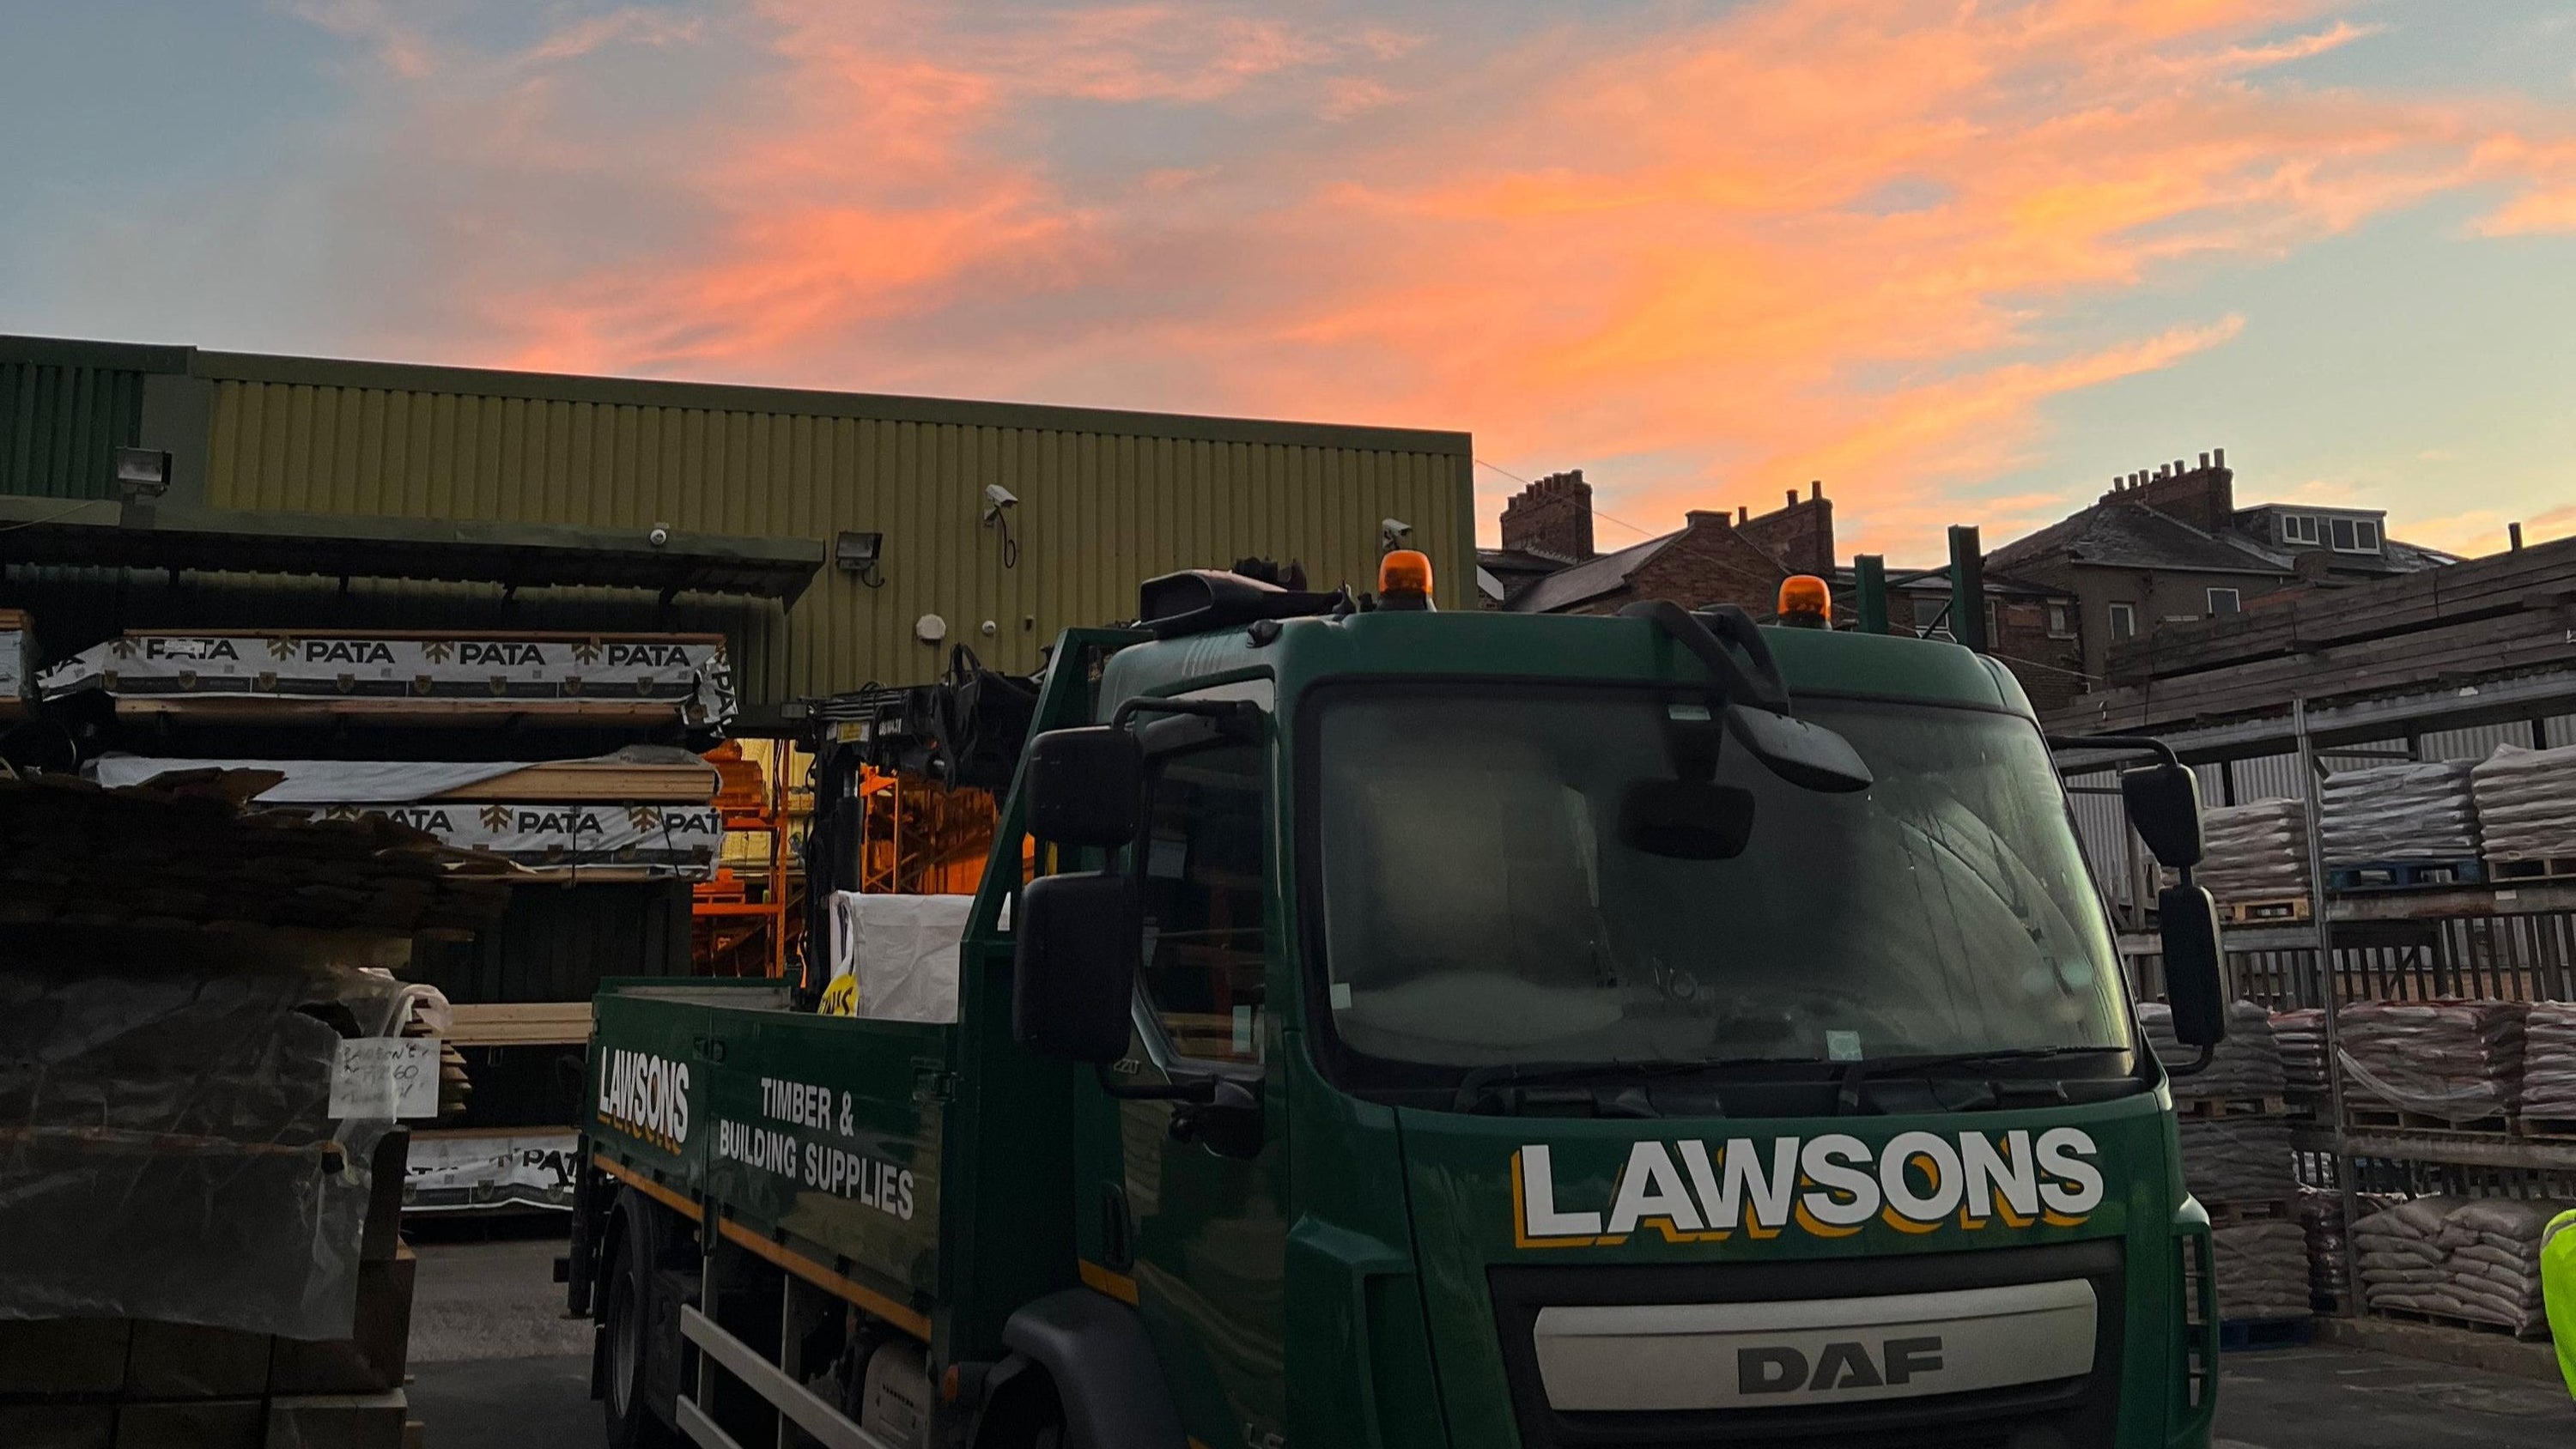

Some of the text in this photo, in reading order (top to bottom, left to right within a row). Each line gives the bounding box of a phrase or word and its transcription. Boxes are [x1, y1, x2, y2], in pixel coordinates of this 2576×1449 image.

[306, 642, 395, 664] PATA
[459, 643, 545, 665] PATA
[608, 645, 690, 666] PATA
[518, 812, 603, 834] PATA
[598, 1046, 690, 1154] LAWSONS
[761, 1077, 854, 1137] TIMBER &
[720, 1119, 914, 1221] BUILDING SUPPLIES
[1511, 1126, 2105, 1249] LAWSONS
[1737, 1337, 1943, 1395] DAF
